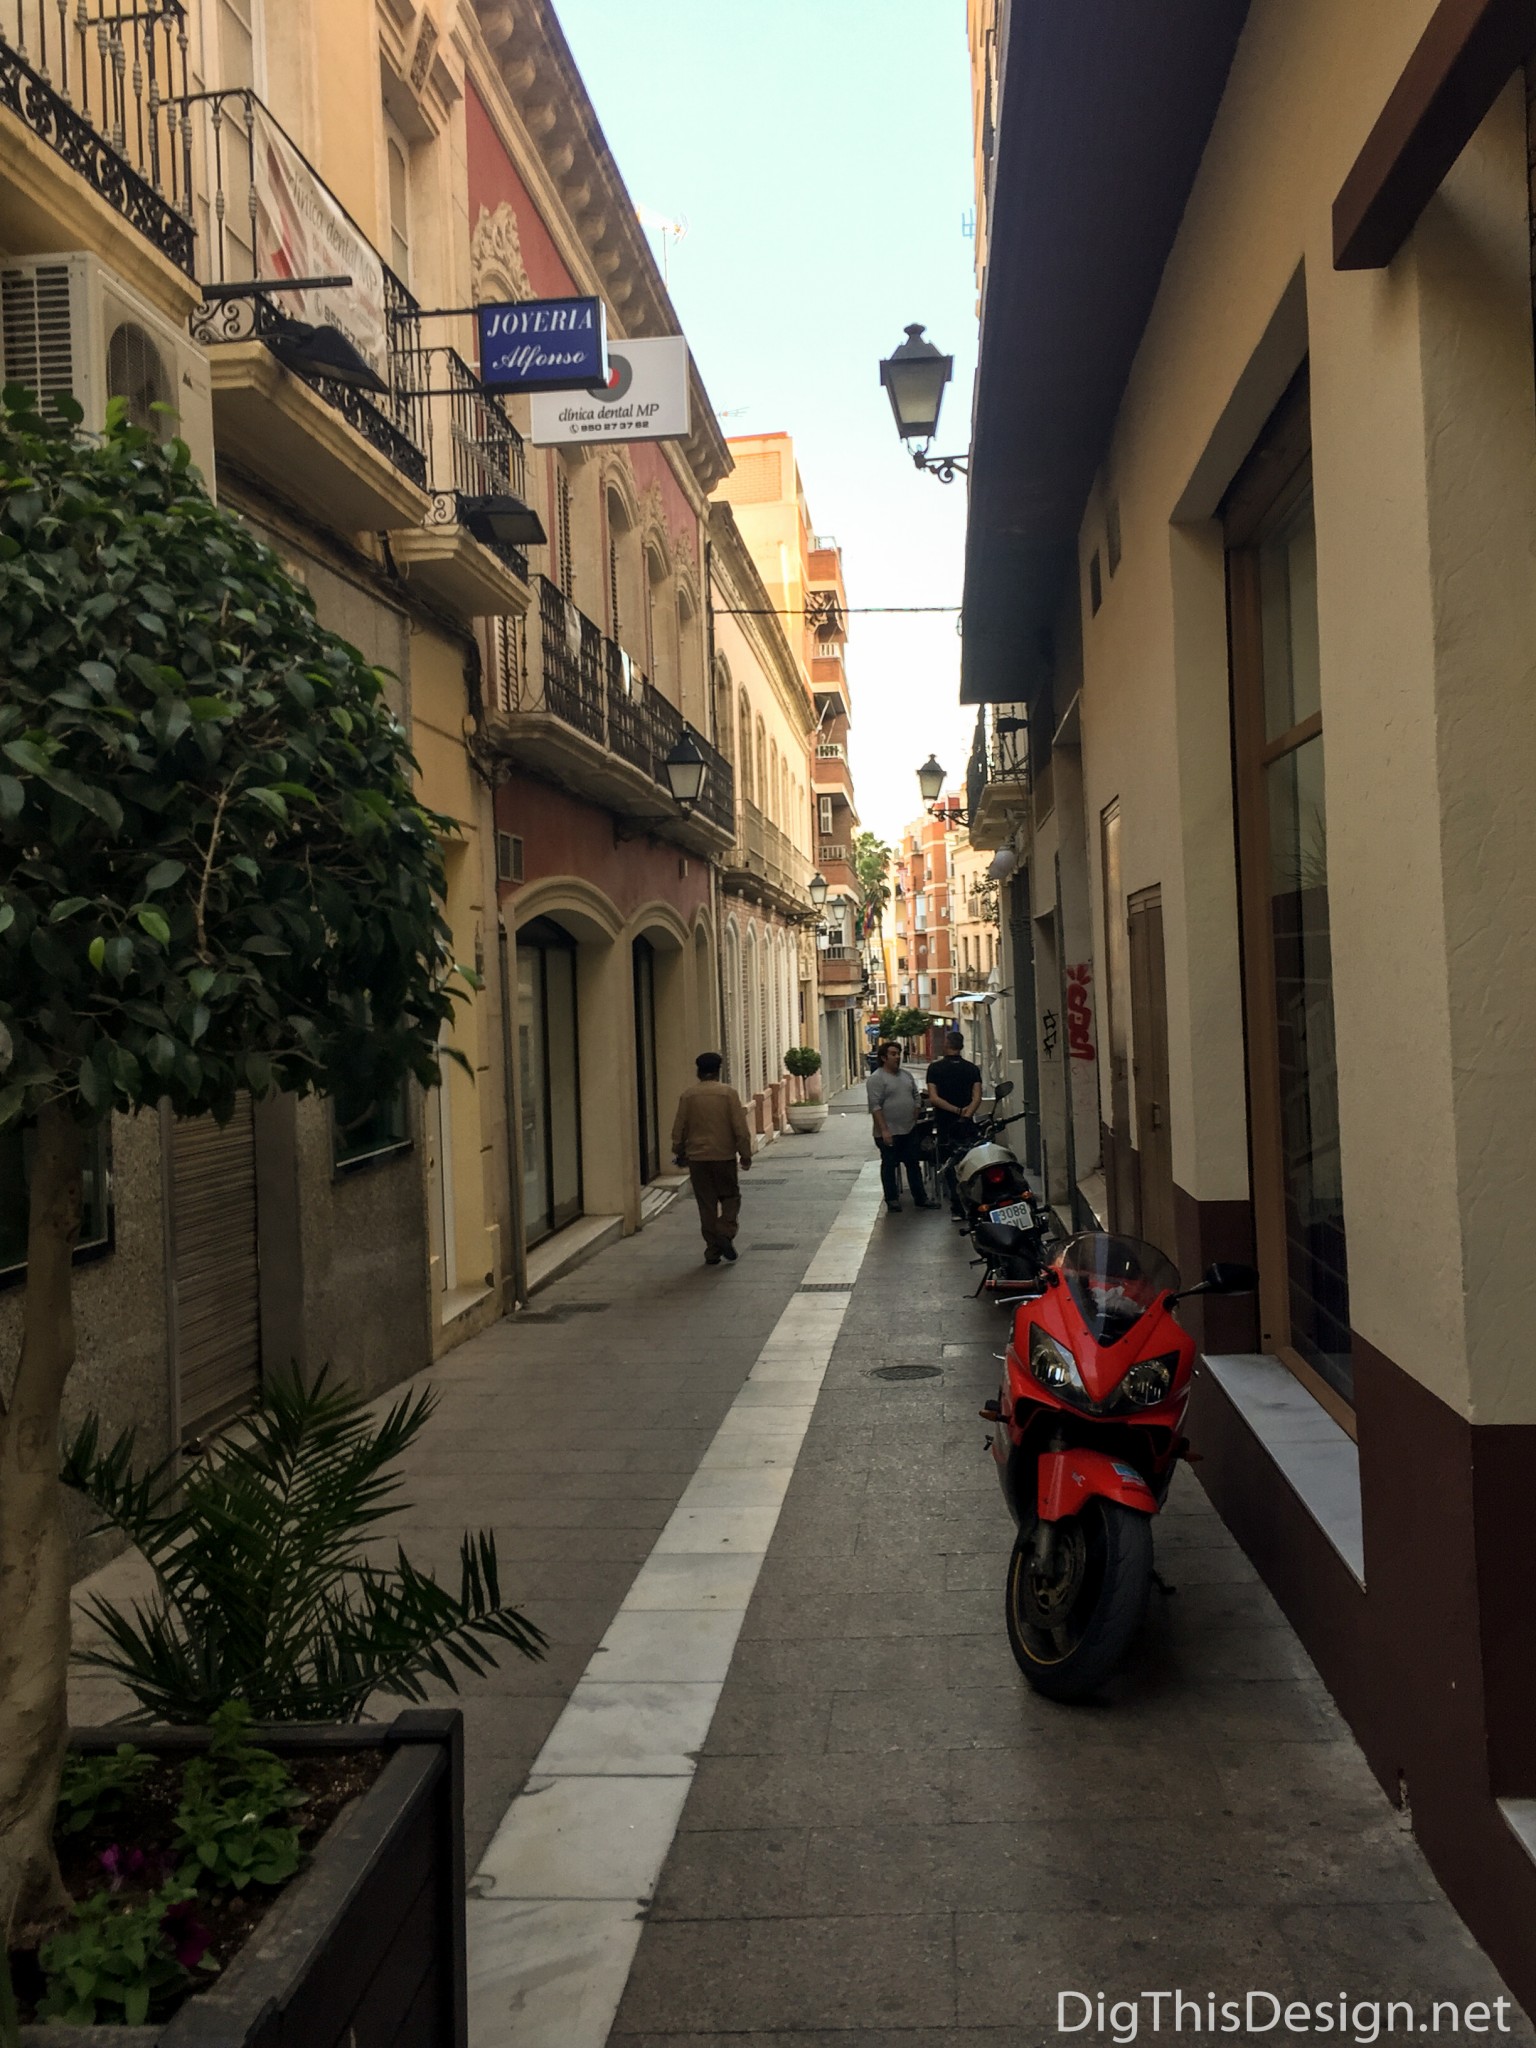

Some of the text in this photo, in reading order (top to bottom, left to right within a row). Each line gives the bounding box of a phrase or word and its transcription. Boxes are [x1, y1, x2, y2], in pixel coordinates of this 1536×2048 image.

[326, 217, 359, 271] dental
[487, 307, 593, 338] JOYERIA
[492, 345, 587, 376] Alfonso
[558, 403, 660, 422] clínica dental MP
[999, 1204, 1027, 1220] 3088
